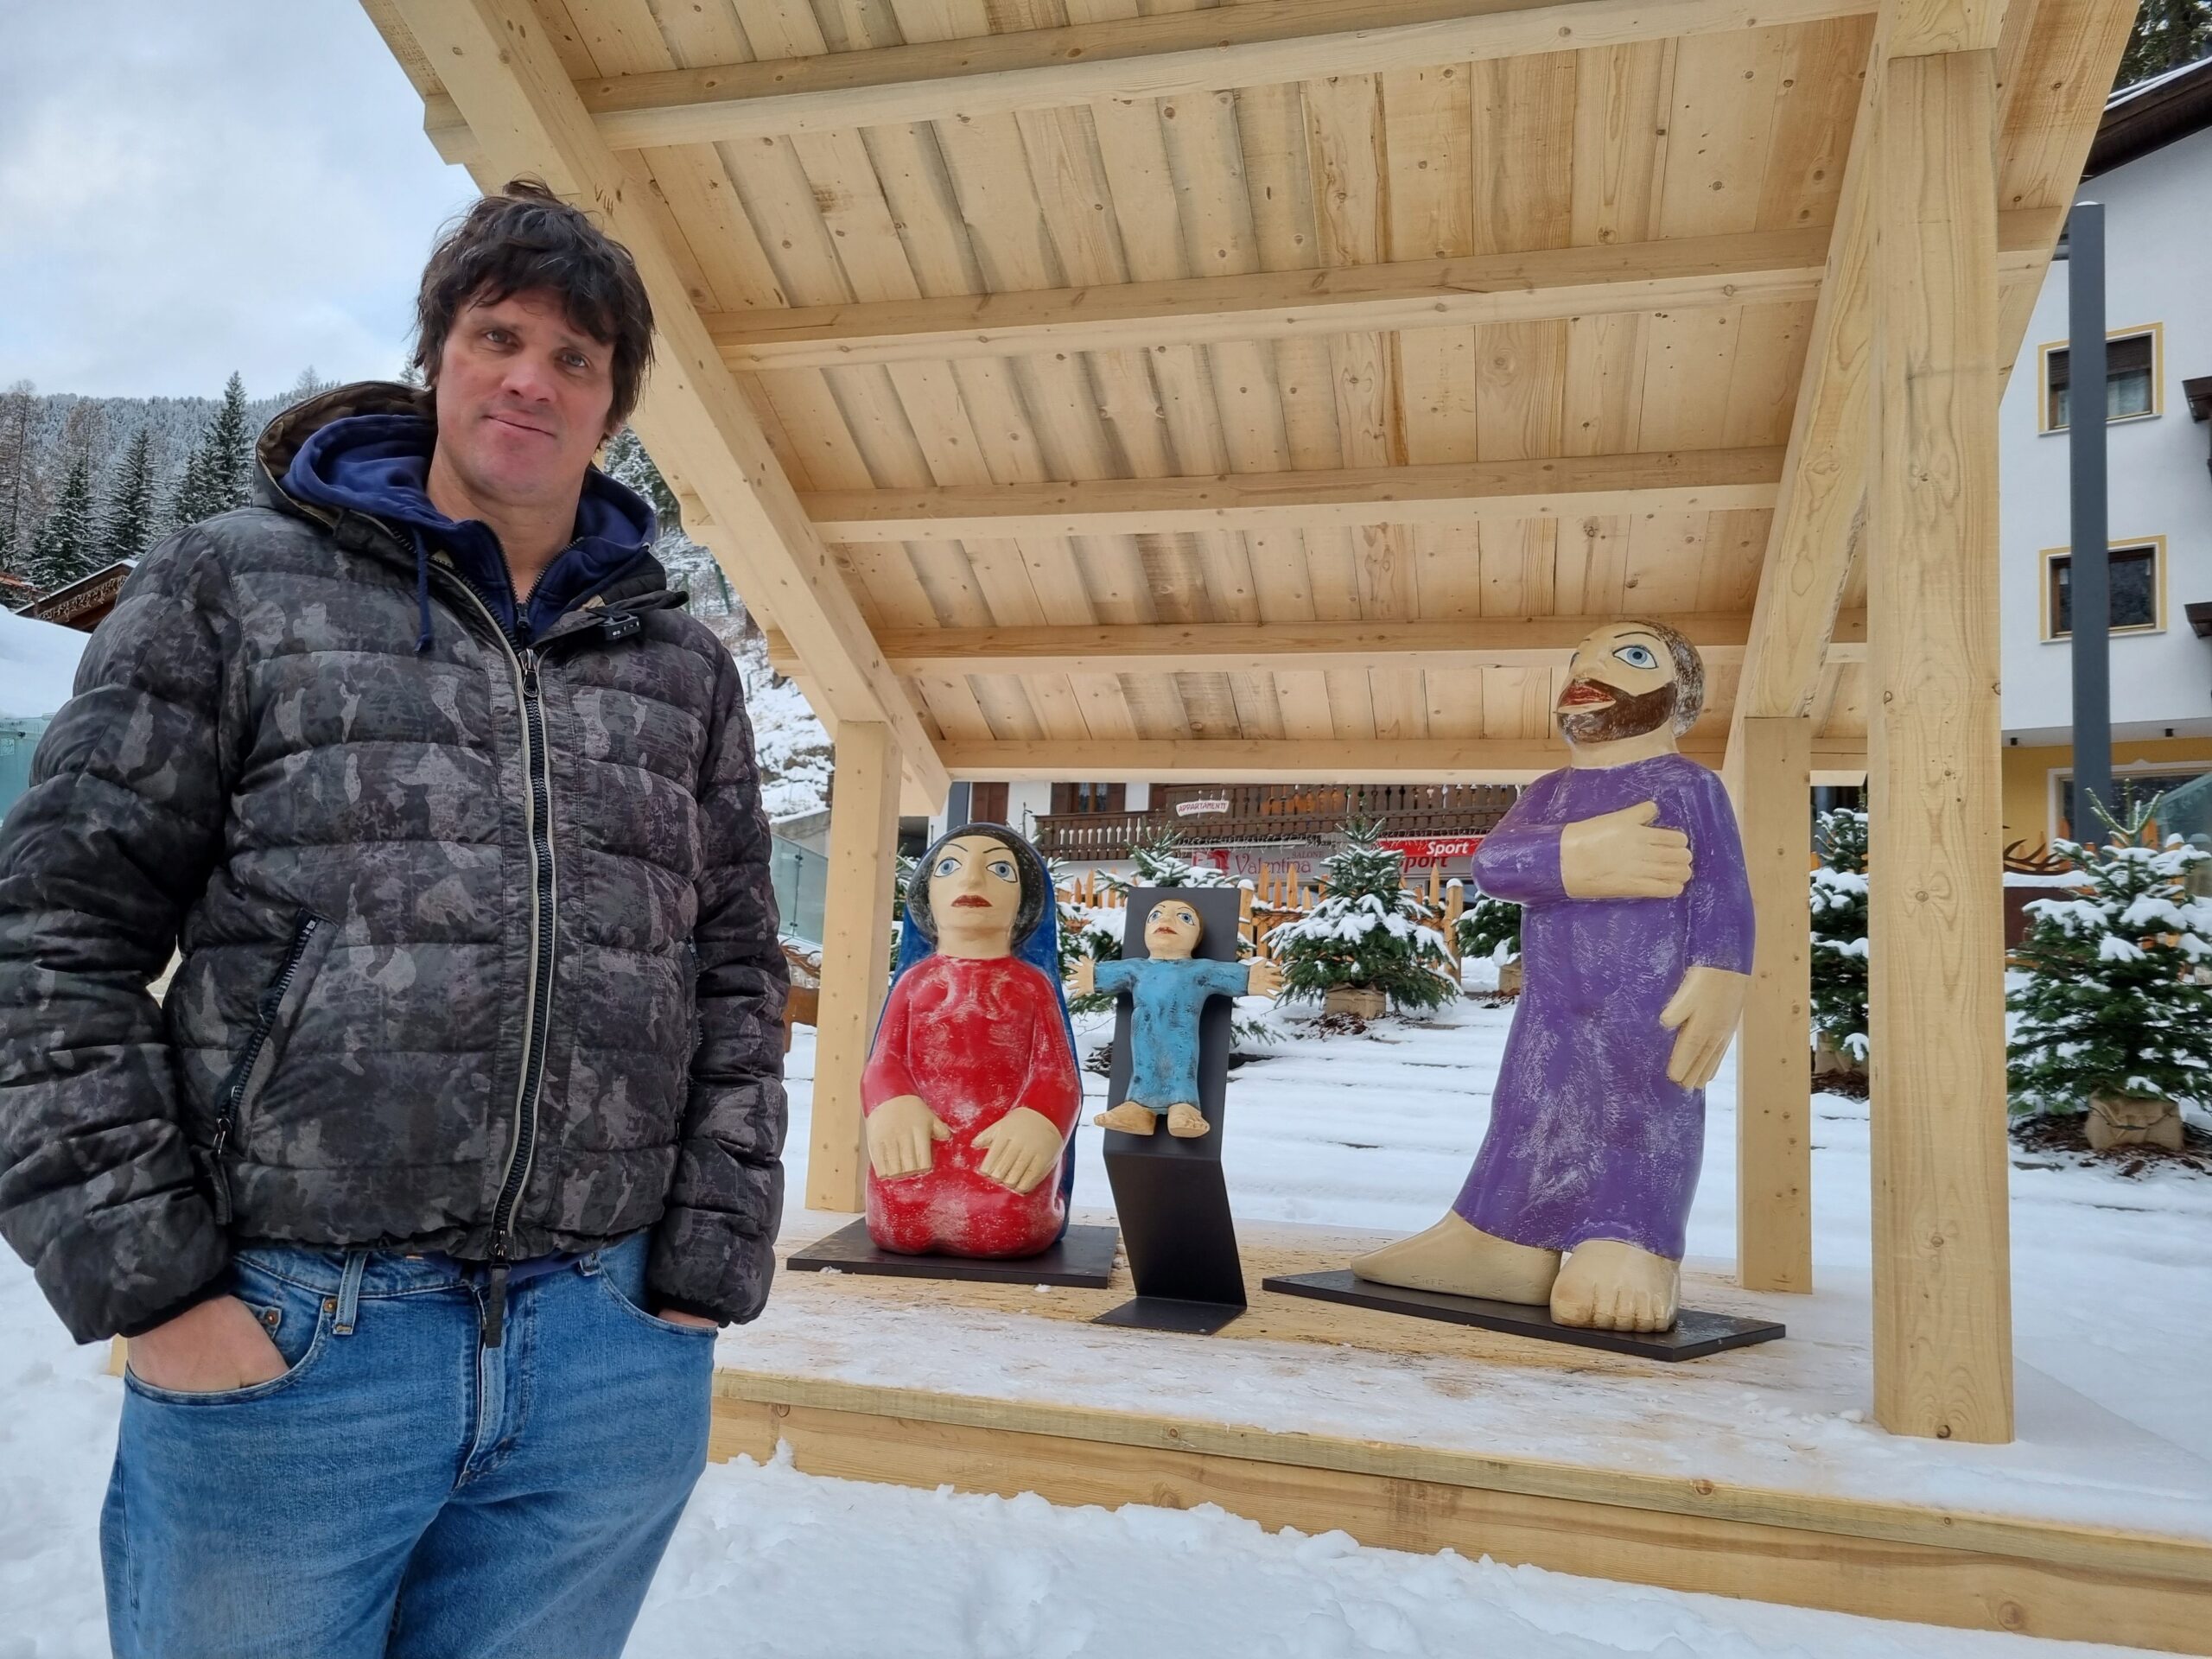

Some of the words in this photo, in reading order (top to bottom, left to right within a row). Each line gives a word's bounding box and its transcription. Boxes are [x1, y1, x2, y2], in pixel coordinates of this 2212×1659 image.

[1179, 802, 1227, 812] APPARTAMENTI
[1292, 850, 1324, 859] SALONE
[1427, 842, 1469, 856] Sport
[1235, 853, 1312, 874] Valntina
[1400, 856, 1449, 874] port
